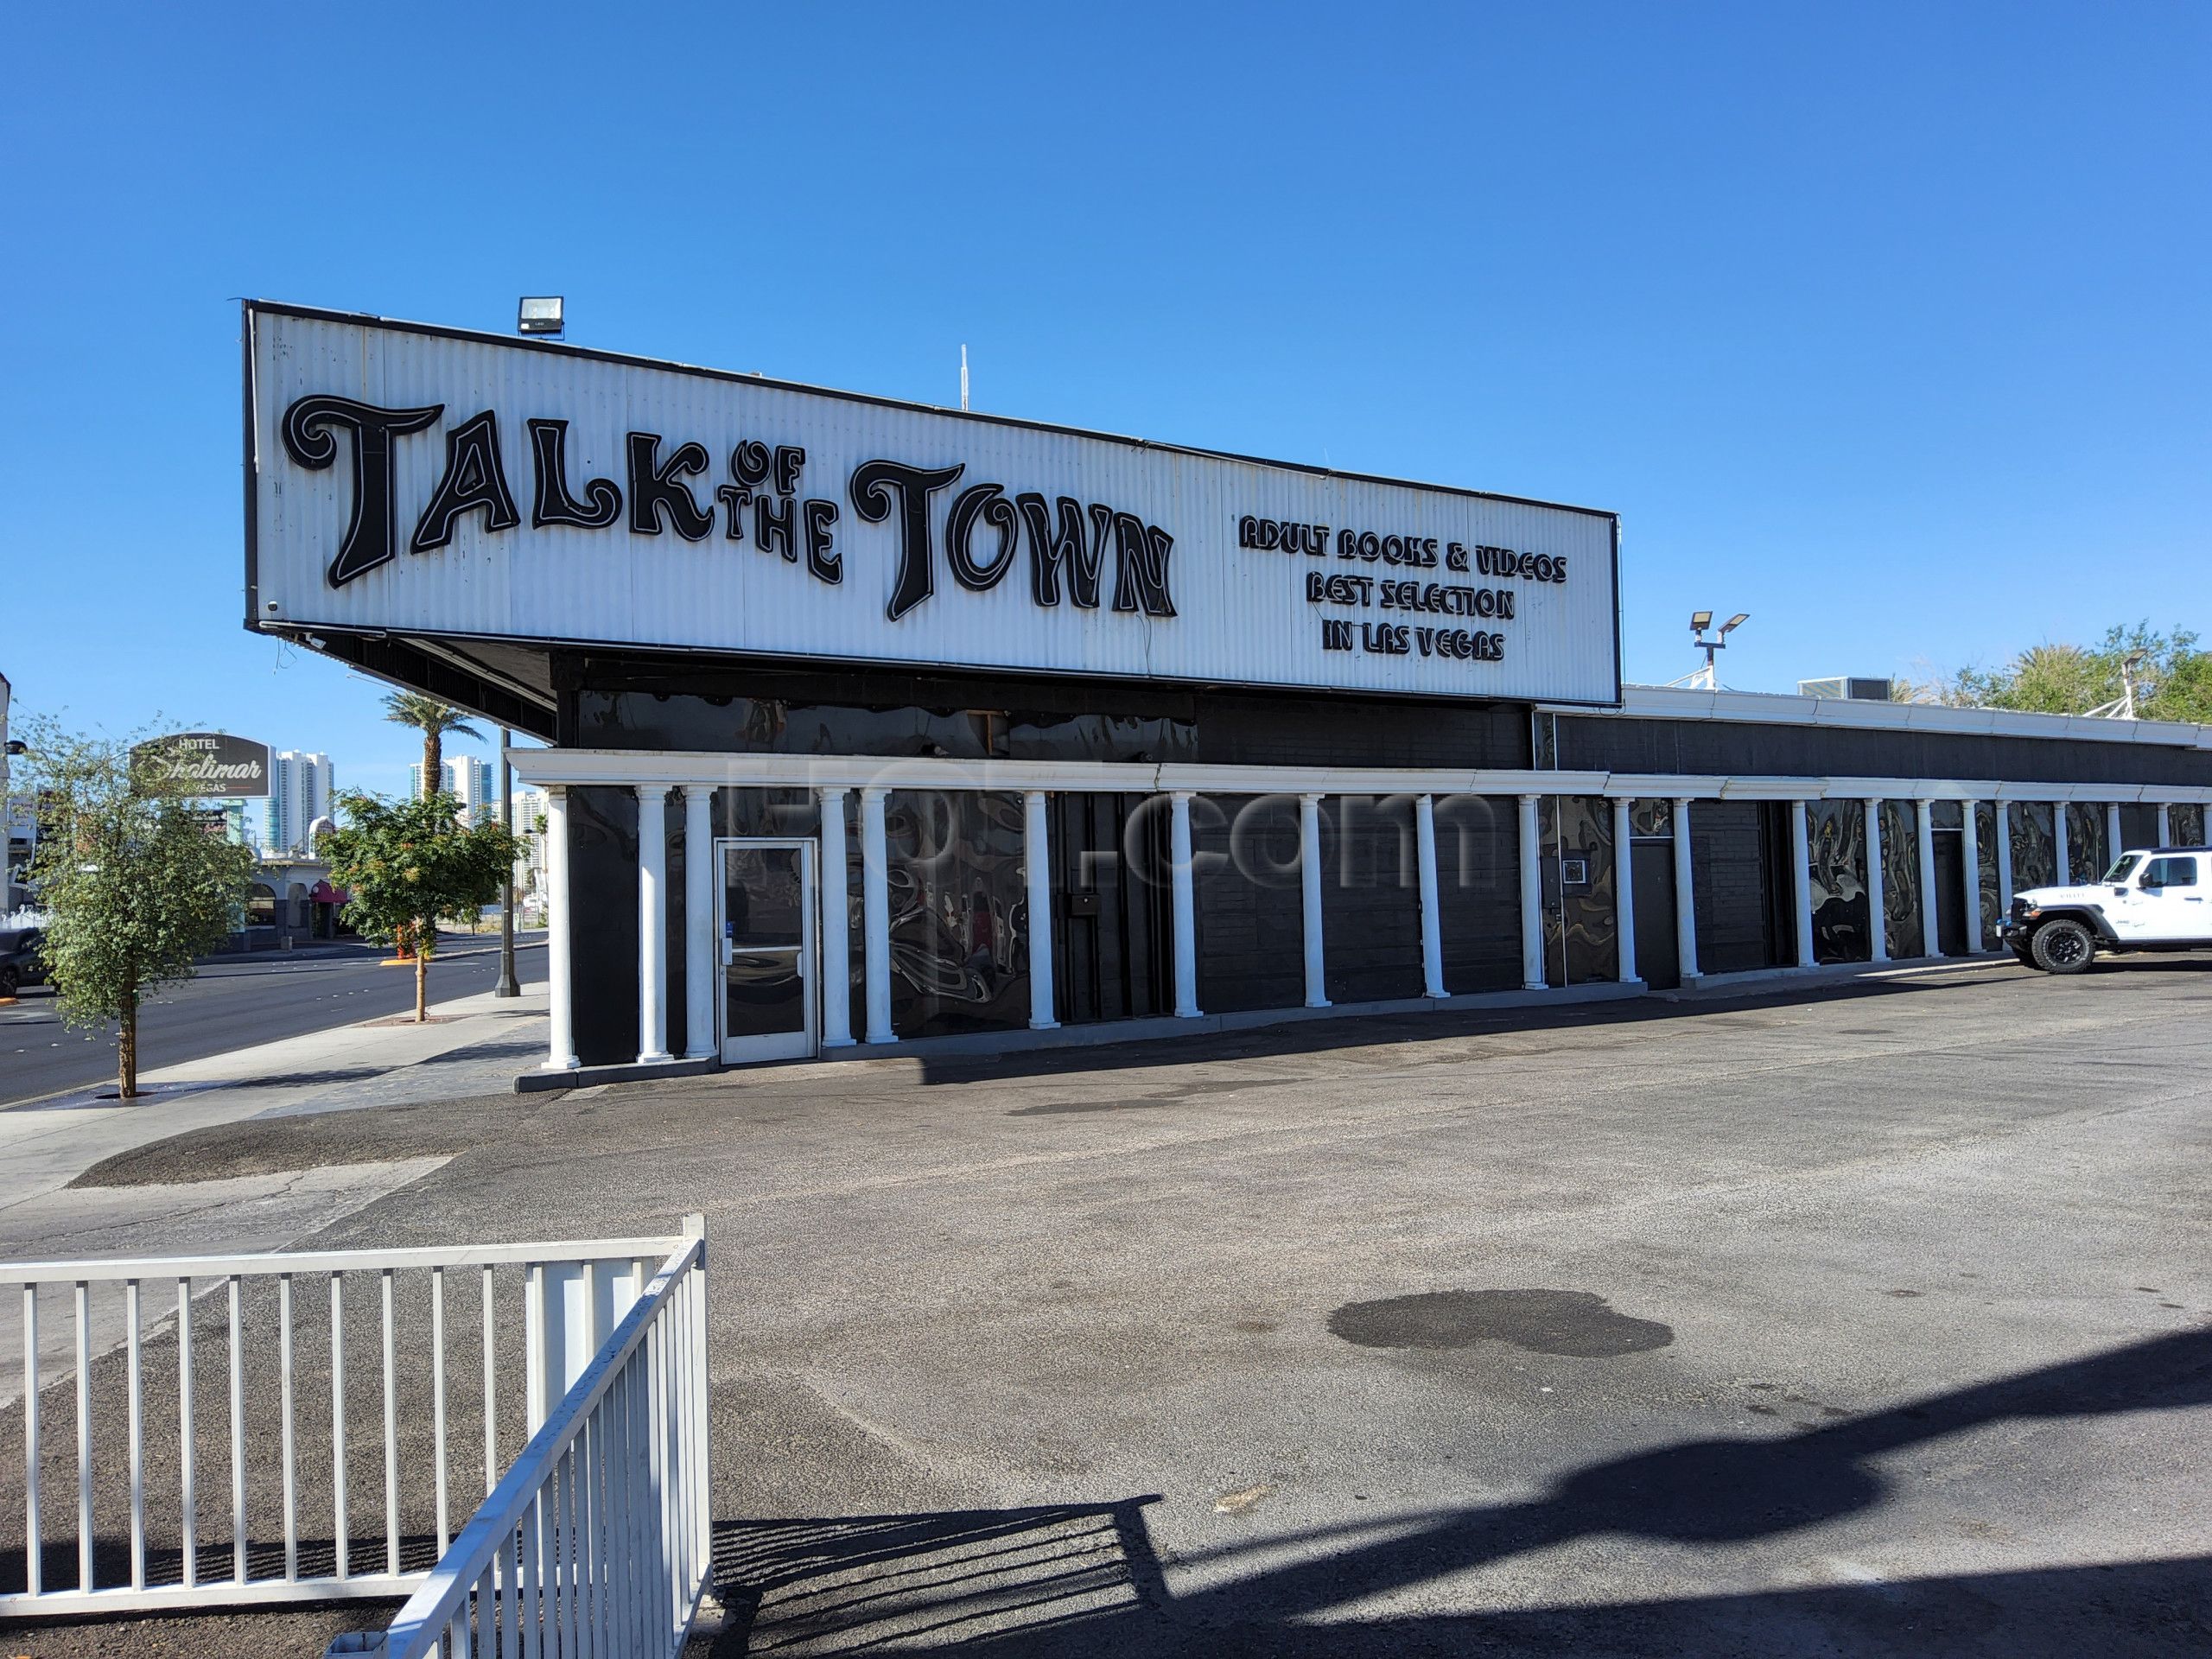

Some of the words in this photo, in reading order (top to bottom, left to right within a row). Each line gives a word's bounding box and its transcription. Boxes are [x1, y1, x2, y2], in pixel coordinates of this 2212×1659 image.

[281, 394, 715, 589] TALK
[732, 439, 805, 495] OF
[717, 485, 843, 585] THE
[849, 459, 1178, 622] TOWN
[1239, 515, 1330, 556] ADULT
[1338, 529, 1439, 568] BOOKS
[1445, 543, 1470, 572] &
[1476, 545, 1567, 583] VIDEOS
[1306, 571, 1374, 607] BEST
[1380, 580, 1515, 620] SELECTION
[1323, 620, 1353, 651] IN
[1363, 622, 1409, 654] LAS
[1416, 626, 1505, 661] VEGAS
[179, 738, 219, 750] HOTEL
